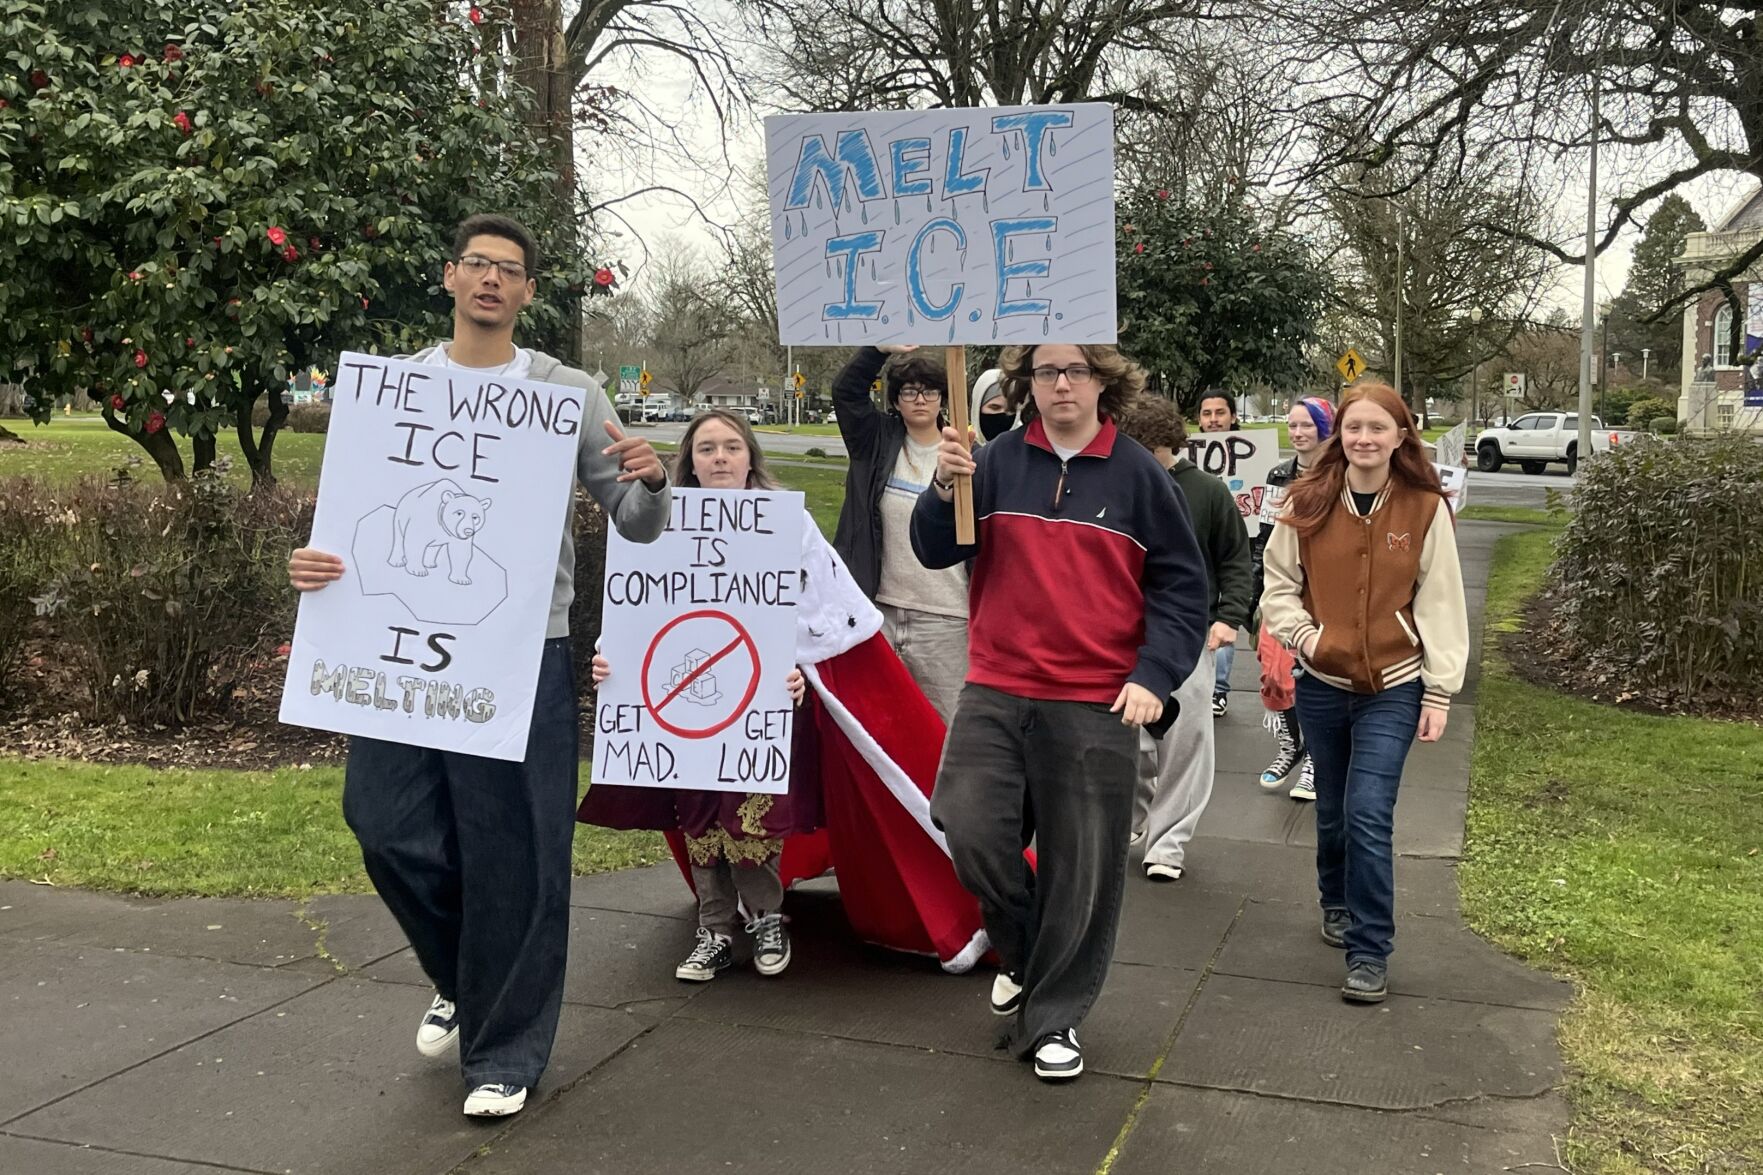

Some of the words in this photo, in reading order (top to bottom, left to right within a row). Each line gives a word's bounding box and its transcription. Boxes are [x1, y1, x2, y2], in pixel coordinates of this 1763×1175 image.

[783, 110, 1075, 220] MELT
[821, 215, 1064, 322] I.C.E.
[343, 362, 432, 413] THE
[448, 378, 581, 436] WRONG
[387, 421, 502, 483] ICE
[1172, 436, 1257, 476] TOP
[663, 495, 774, 535] ILENCE
[689, 536, 729, 568] IS
[606, 570, 797, 607] COMPLIANCE
[379, 625, 457, 673] IS
[310, 658, 497, 724] MELTING
[599, 703, 648, 734] GET
[744, 709, 793, 741] GET
[602, 740, 679, 783] MAD.
[717, 742, 788, 783] LOUD
